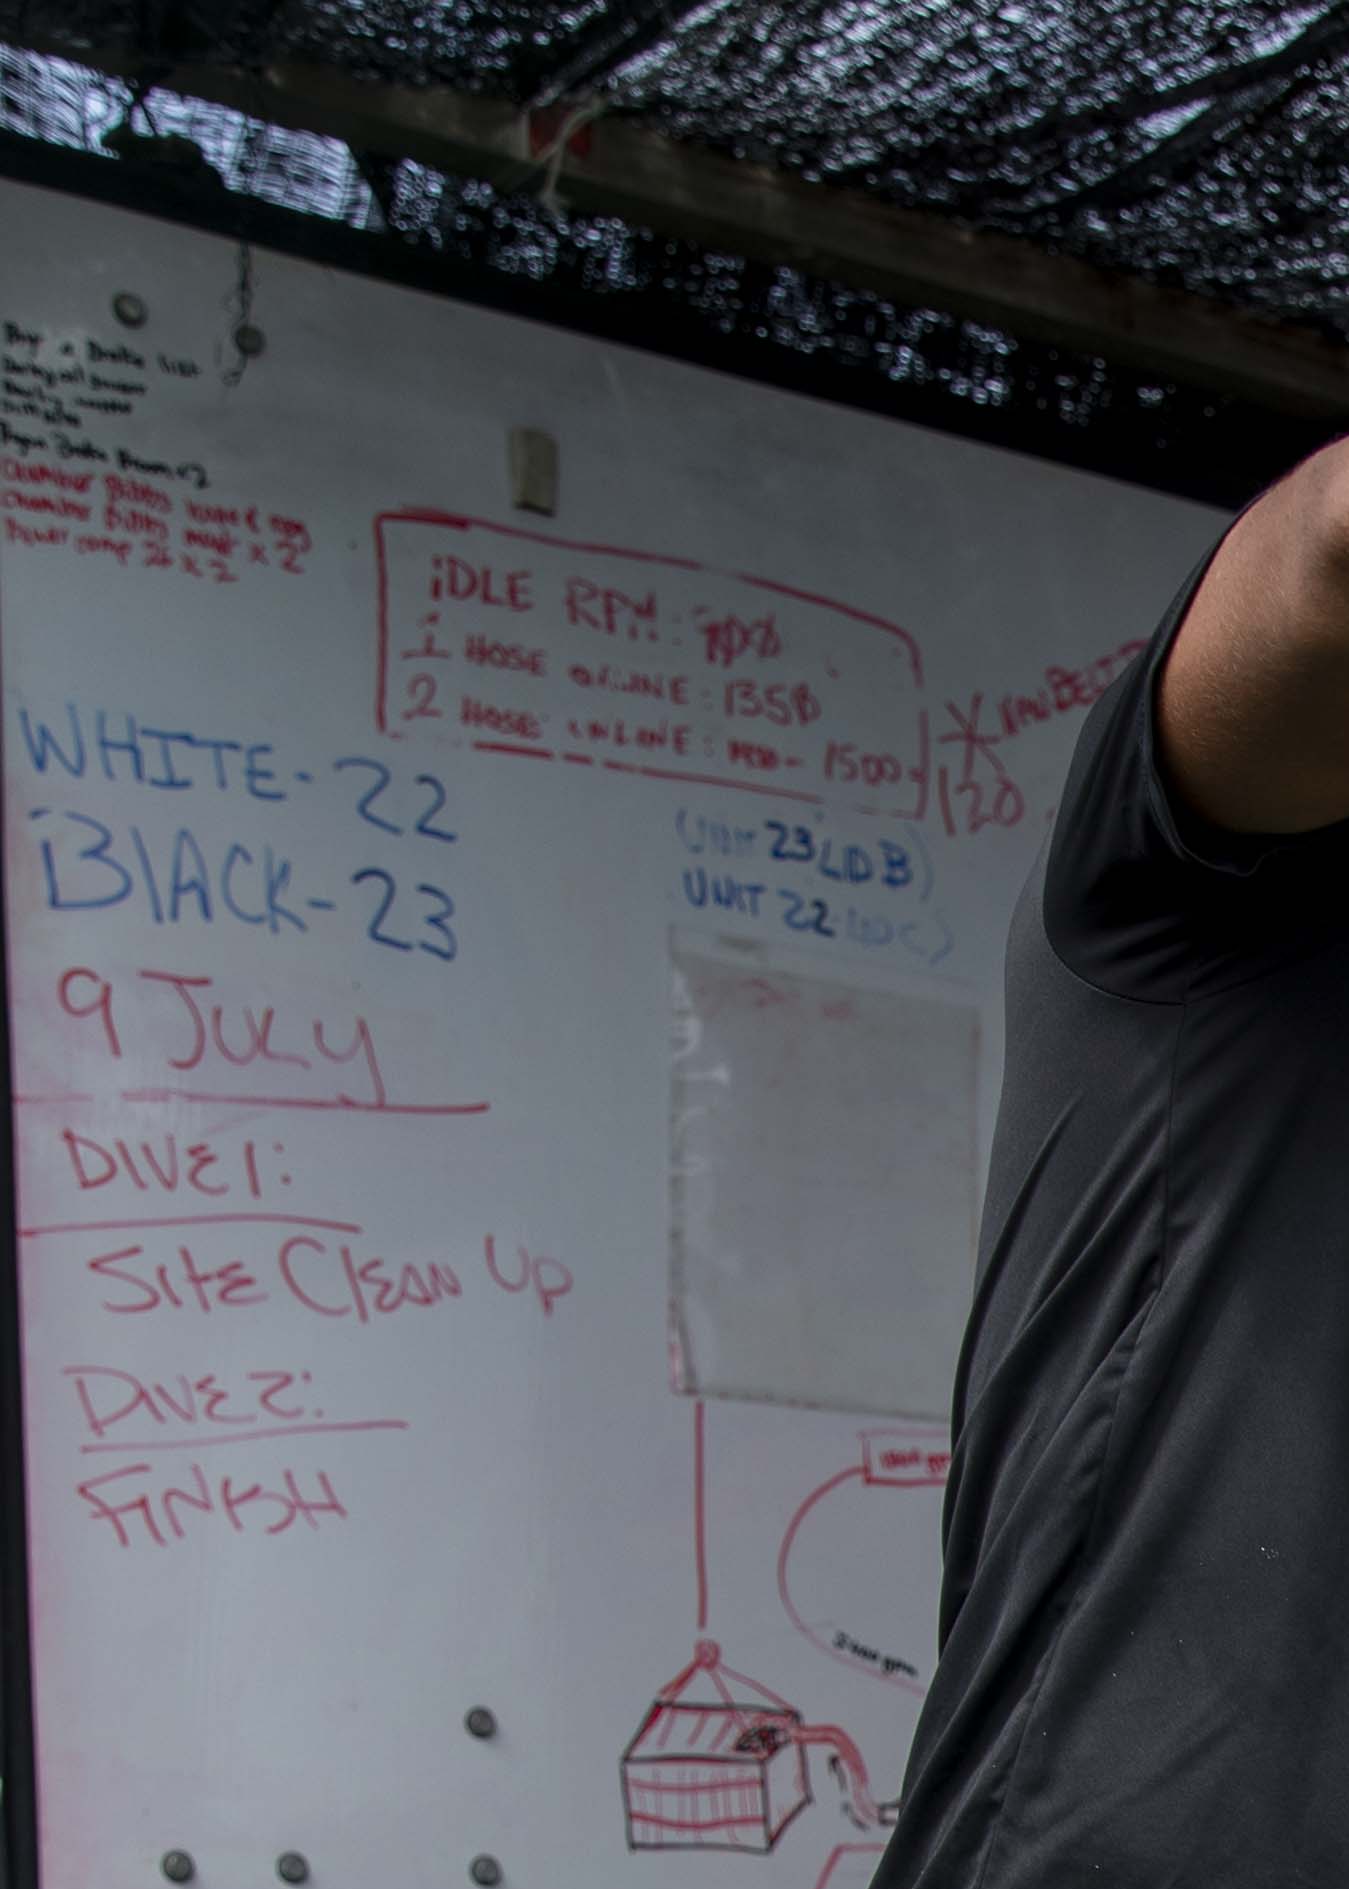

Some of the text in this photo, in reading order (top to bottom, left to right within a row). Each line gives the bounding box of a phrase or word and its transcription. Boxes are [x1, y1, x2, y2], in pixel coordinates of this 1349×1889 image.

[403, 672, 442, 721] 2
[776, 889, 835, 938] 22
[57, 966, 388, 1109] 9 JULY
